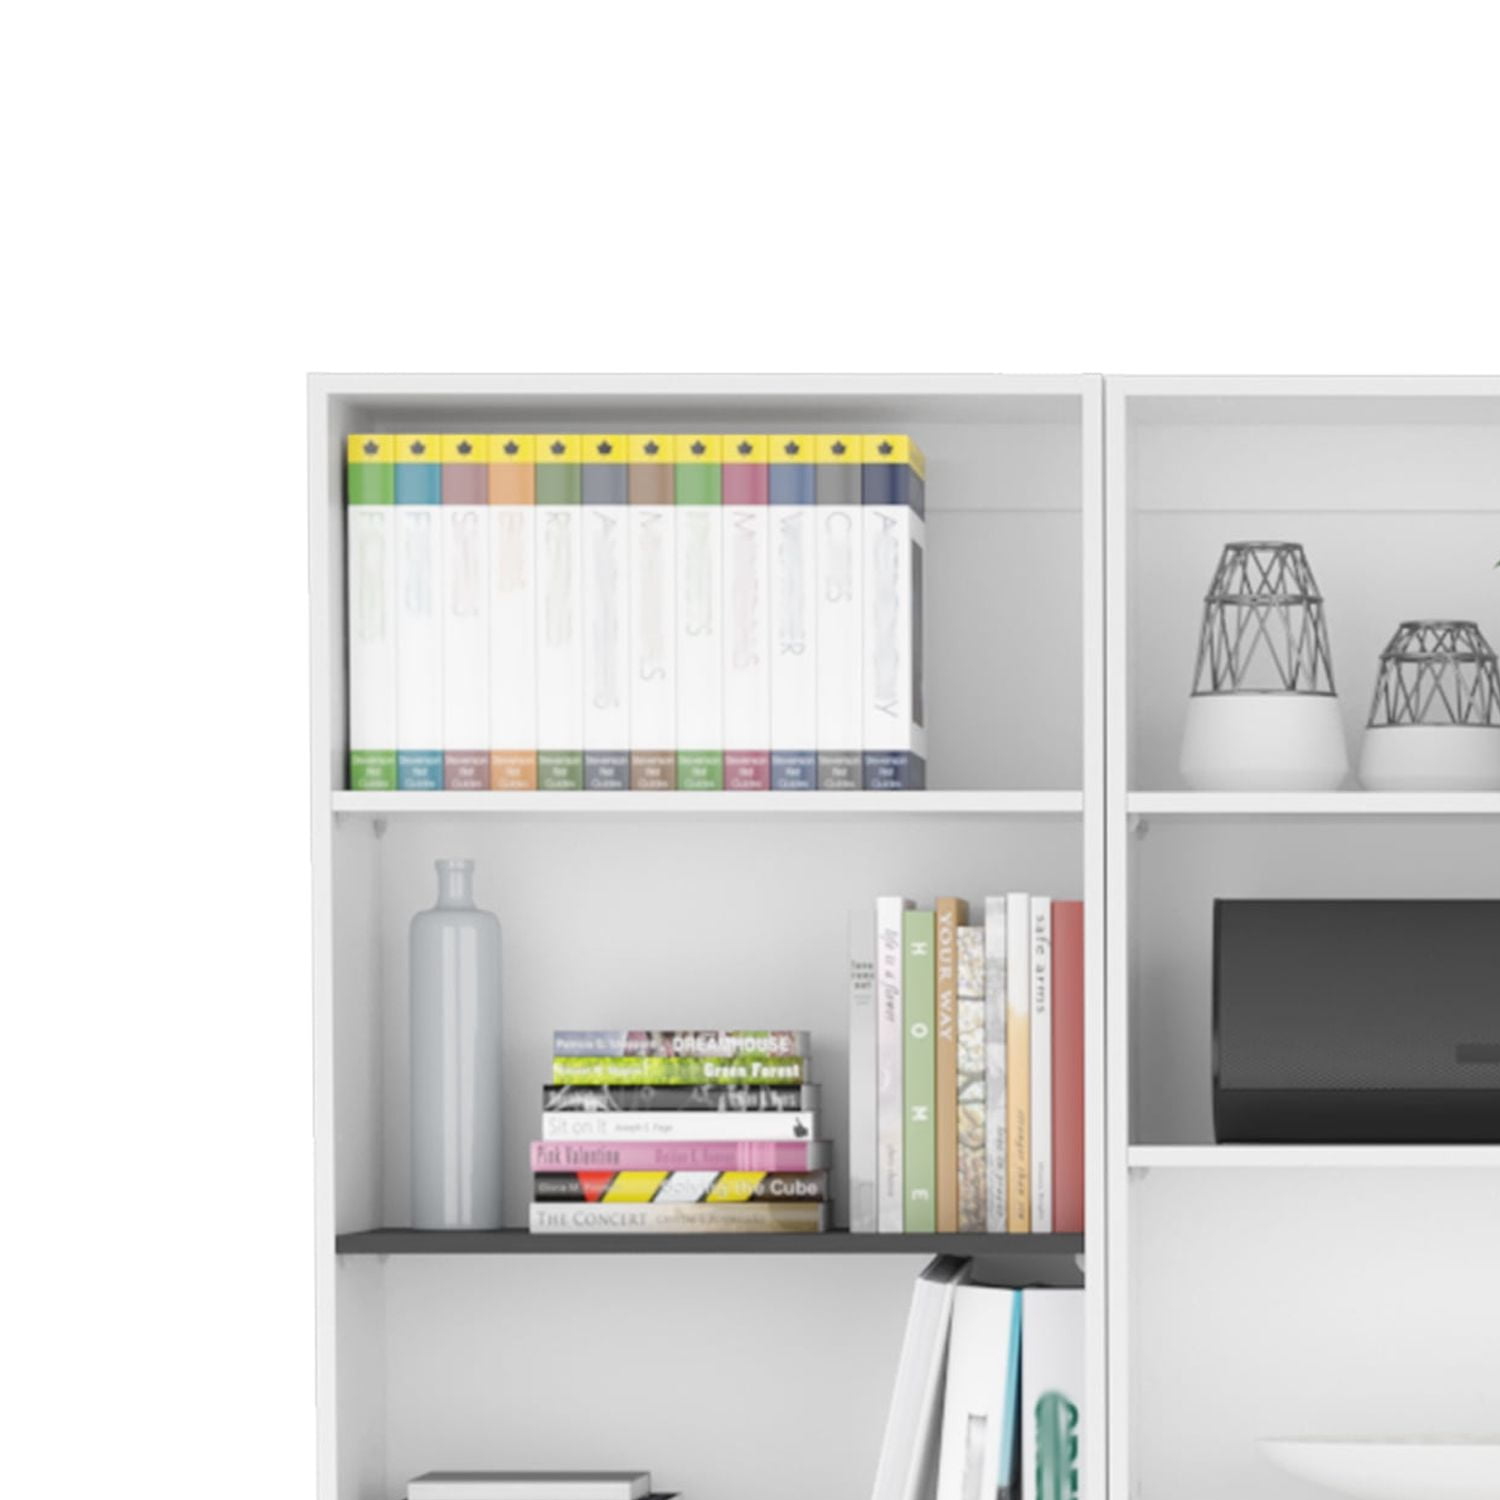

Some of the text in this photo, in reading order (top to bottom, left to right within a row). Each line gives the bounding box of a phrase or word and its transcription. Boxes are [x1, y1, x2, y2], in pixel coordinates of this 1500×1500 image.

[1035, 914, 1050, 1014] safe arms
[939, 911, 953, 1042] YOUR WAY
[703, 1062, 801, 1079] Green Forest
[548, 1117, 568, 1135] Sit
[571, 1119, 593, 1135] on
[537, 1145, 562, 1164] Pink
[769, 1178, 819, 1196] Cube
[535, 1211, 567, 1227] THE
[572, 1211, 648, 1227] CONCERT
